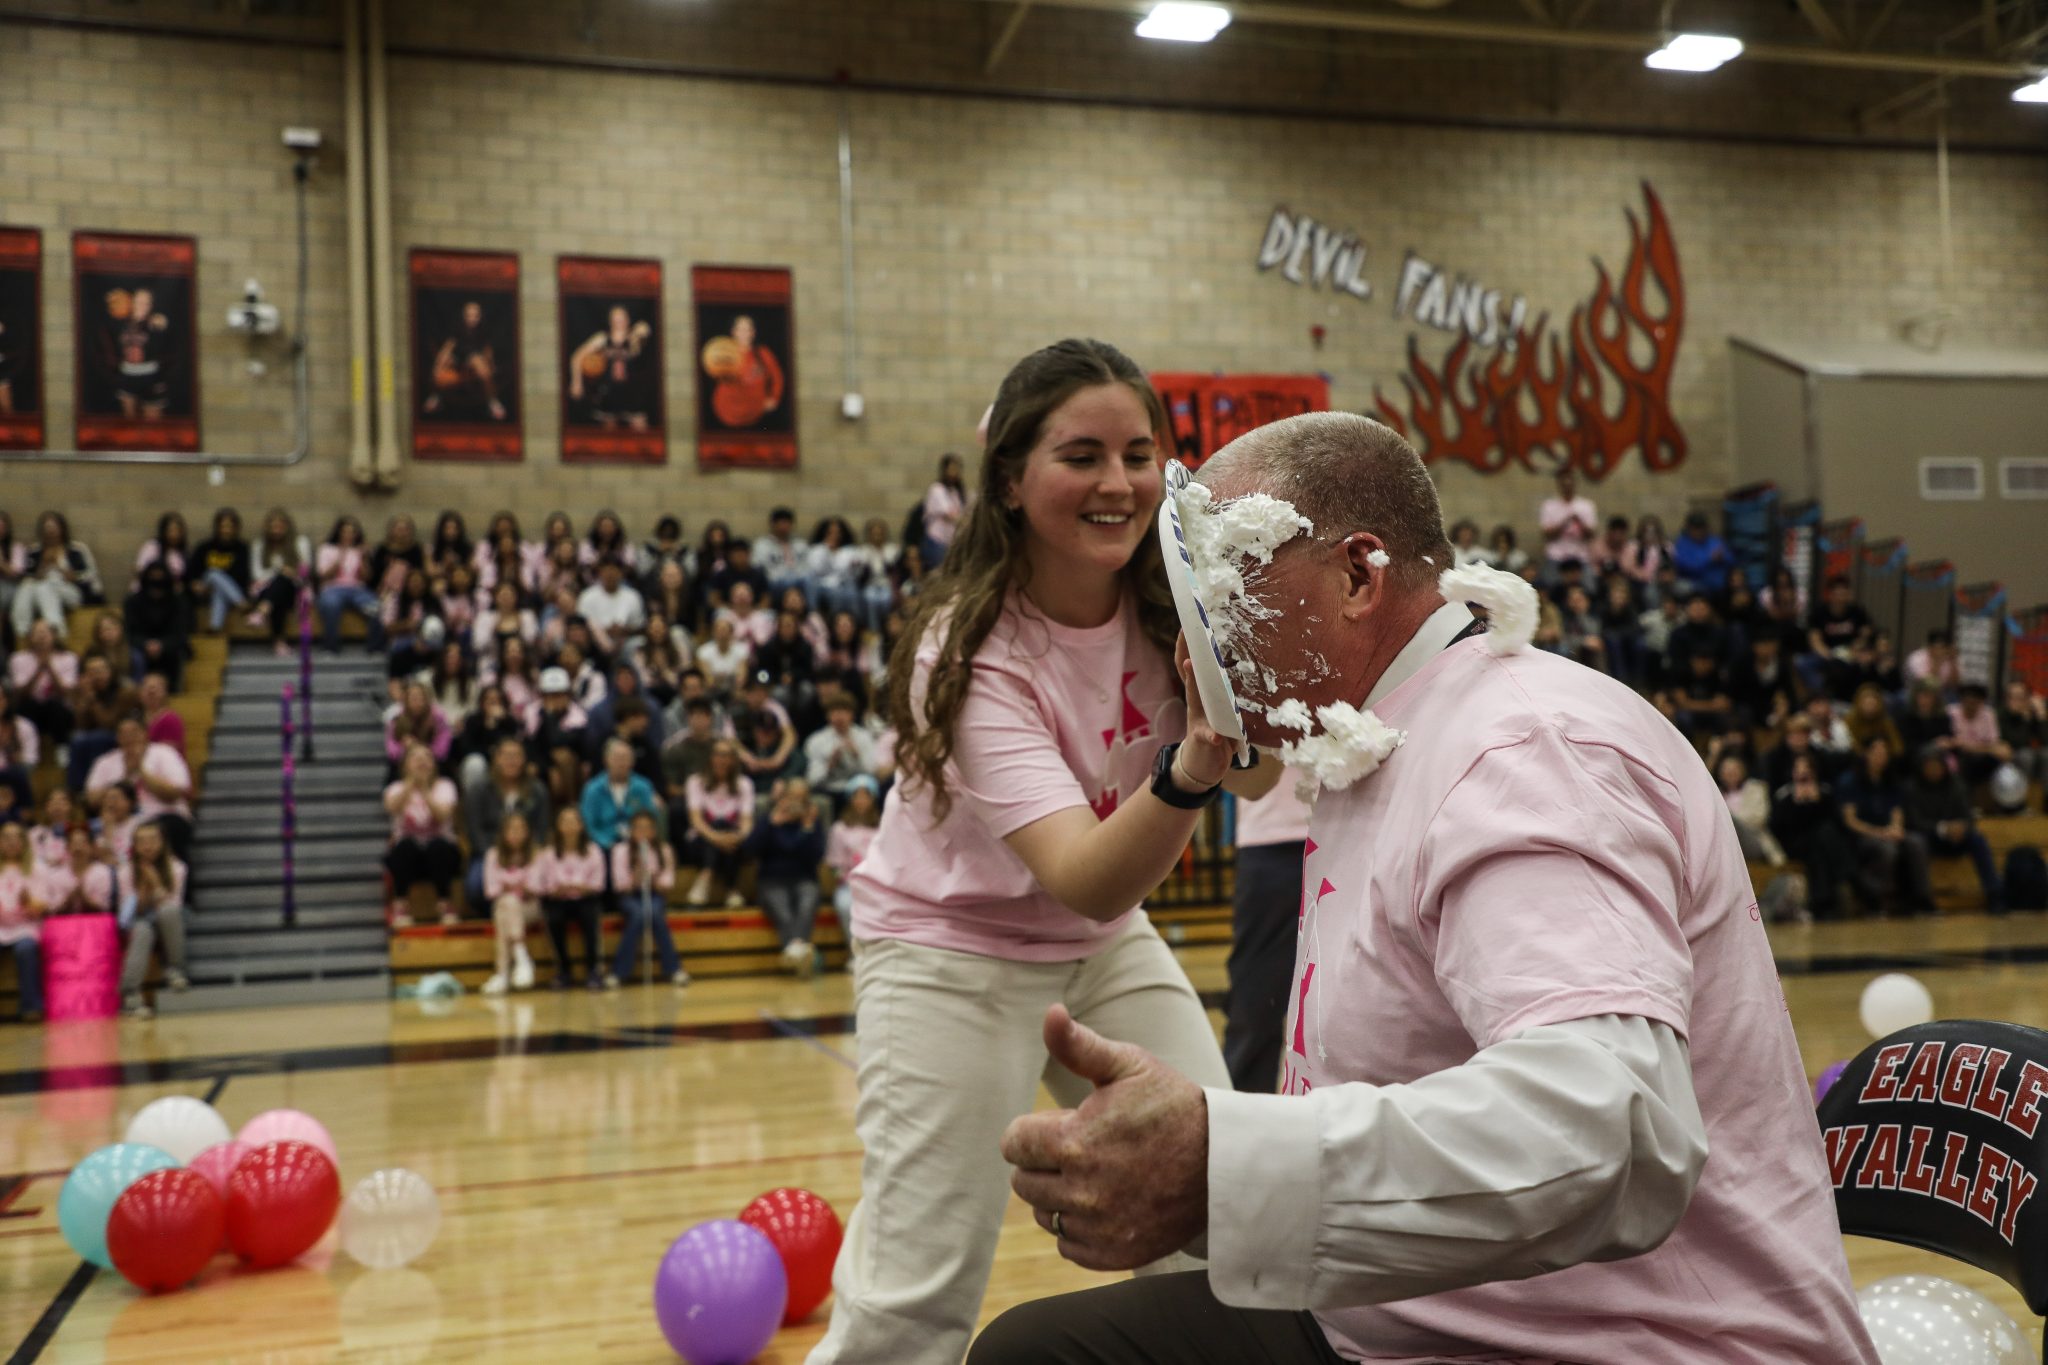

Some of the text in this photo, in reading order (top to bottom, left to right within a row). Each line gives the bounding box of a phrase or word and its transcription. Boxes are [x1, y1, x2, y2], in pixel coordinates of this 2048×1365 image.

[1257, 206, 1372, 299] DEVIL
[1858, 1041, 2048, 1139] EAGLE
[1822, 1124, 2038, 1246] VALLEY
